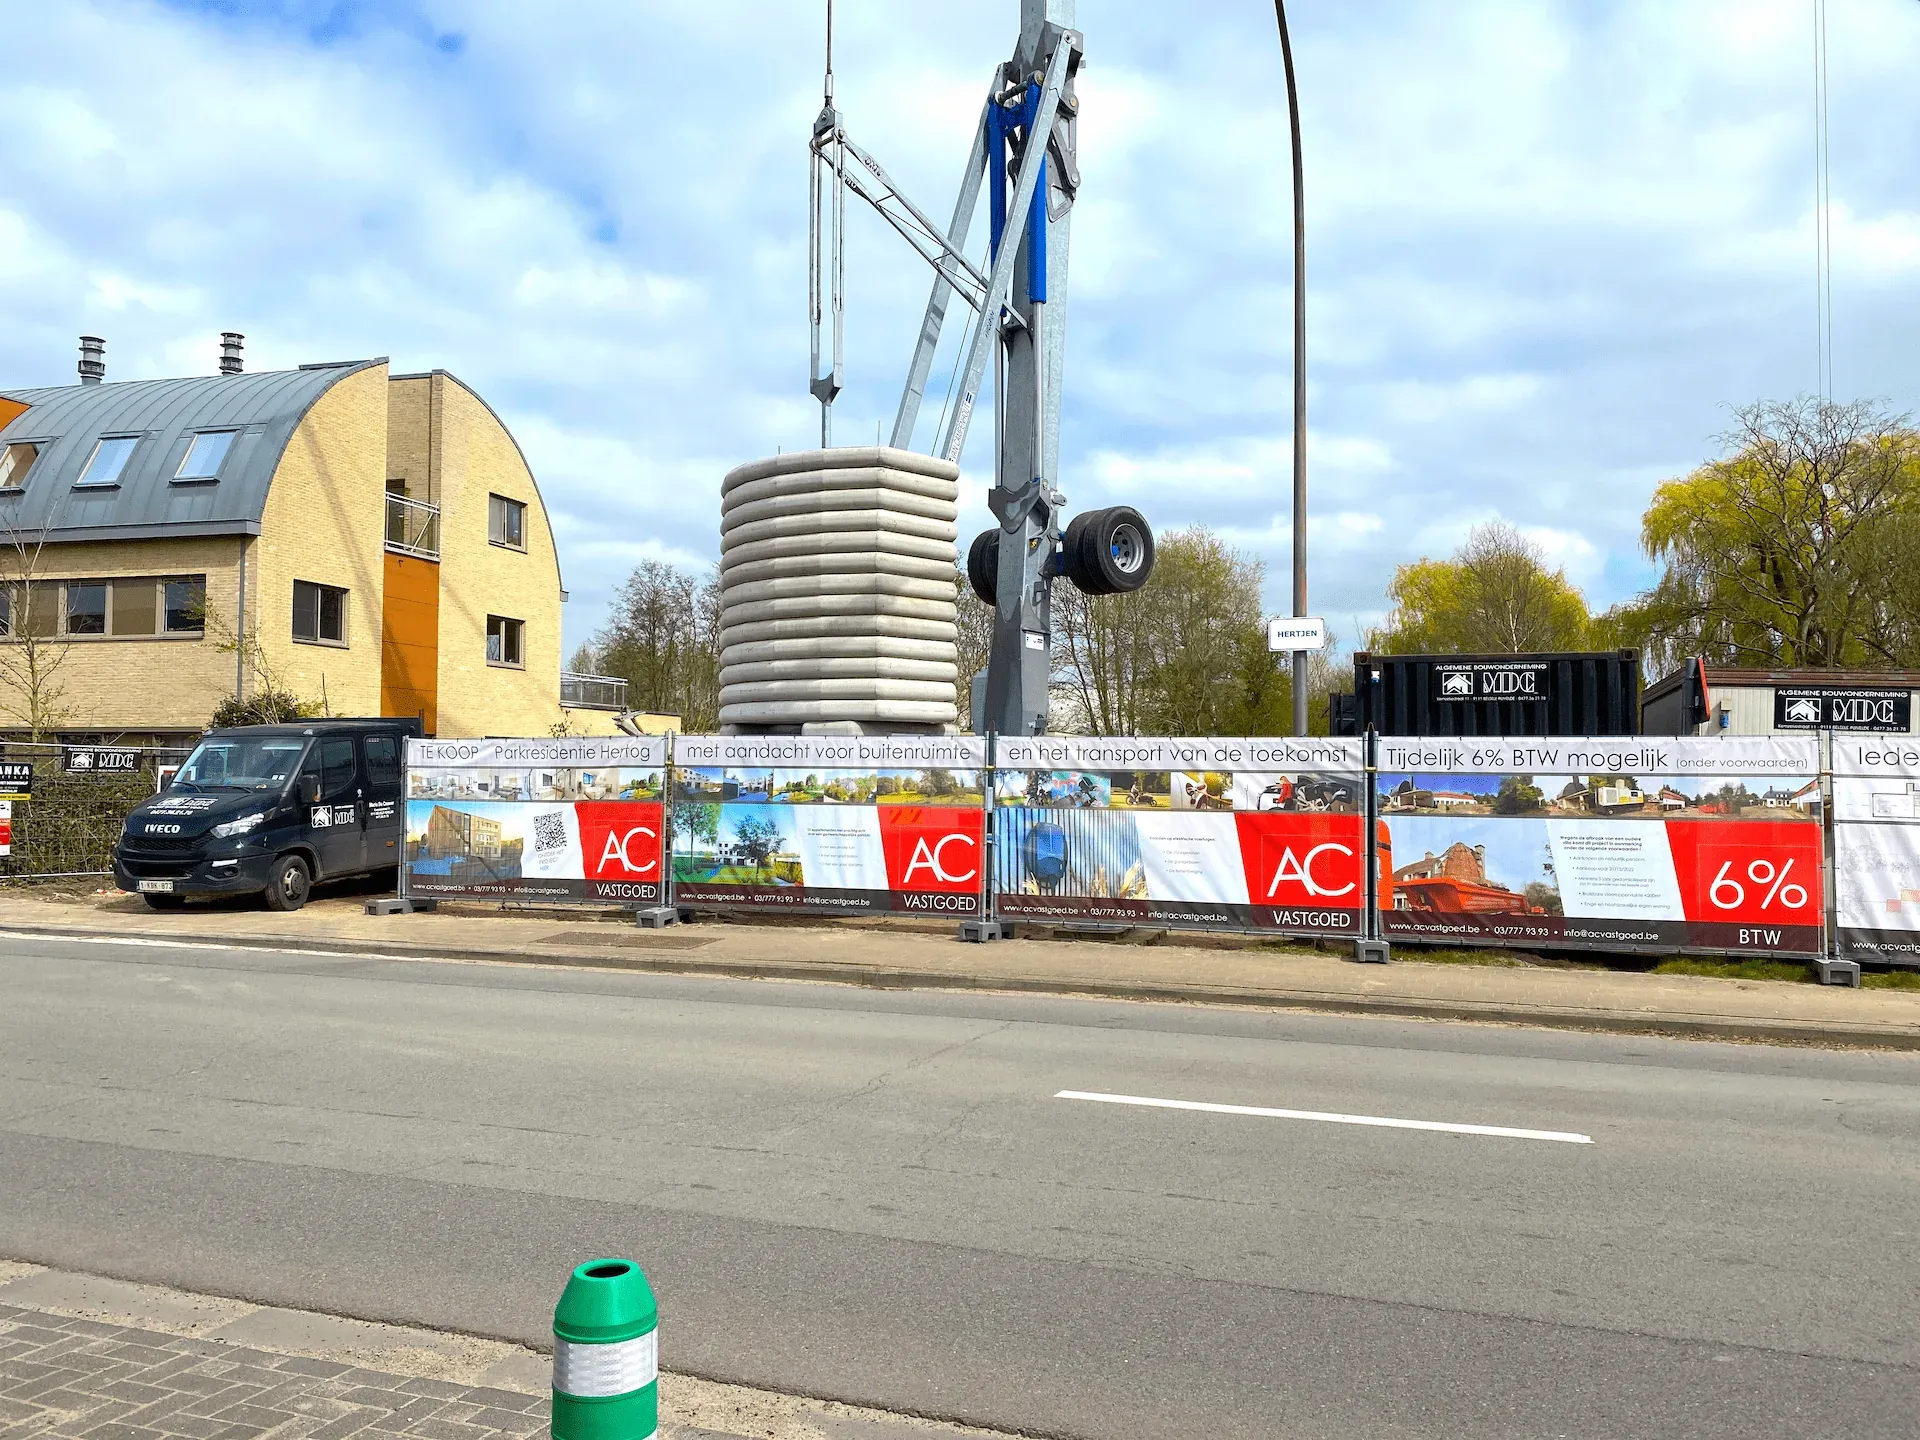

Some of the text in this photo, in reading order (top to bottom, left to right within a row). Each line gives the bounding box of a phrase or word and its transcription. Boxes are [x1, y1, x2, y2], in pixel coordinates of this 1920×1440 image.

[420, 744, 650, 762] TE KOOP Parkresidentie Hertog
[687, 744, 971, 760] met aandacht voor buitenruimte
[1009, 744, 1348, 764] en het transport van de toekomst
[1386, 748, 1808, 772] Tijdelijk 6% BTW mogelijk (onder voorwaarden)
[144, 824, 180, 833] IVECO
[596, 826, 656, 874] AC
[903, 834, 977, 884] AC
[1266, 843, 1356, 897] AC
[412, 884, 466, 892] www.acvastgoed.be
[514, 887, 569, 895] info@acvastgoed.be
[596, 883, 656, 898] VASTGOED
[1708, 857, 1808, 910] 6%
[680, 892, 745, 902] www.acvastgoed.be
[754, 894, 775, 903] 03/777
[803, 896, 870, 907] info@acvastgoed.be
[904, 894, 976, 911] VASTGOED
[1003, 904, 1078, 916] www.acvastgoed.be
[1090, 908, 1116, 917] 03/777
[1147, 910, 1228, 922] info@acvastgoed.be
[1273, 910, 1350, 927] VASTGOED
[1389, 922, 1660, 942] www.acvastgoed.be 03/777 93 93 info@acvastgoed.be
[1738, 929, 1782, 946] BTW
